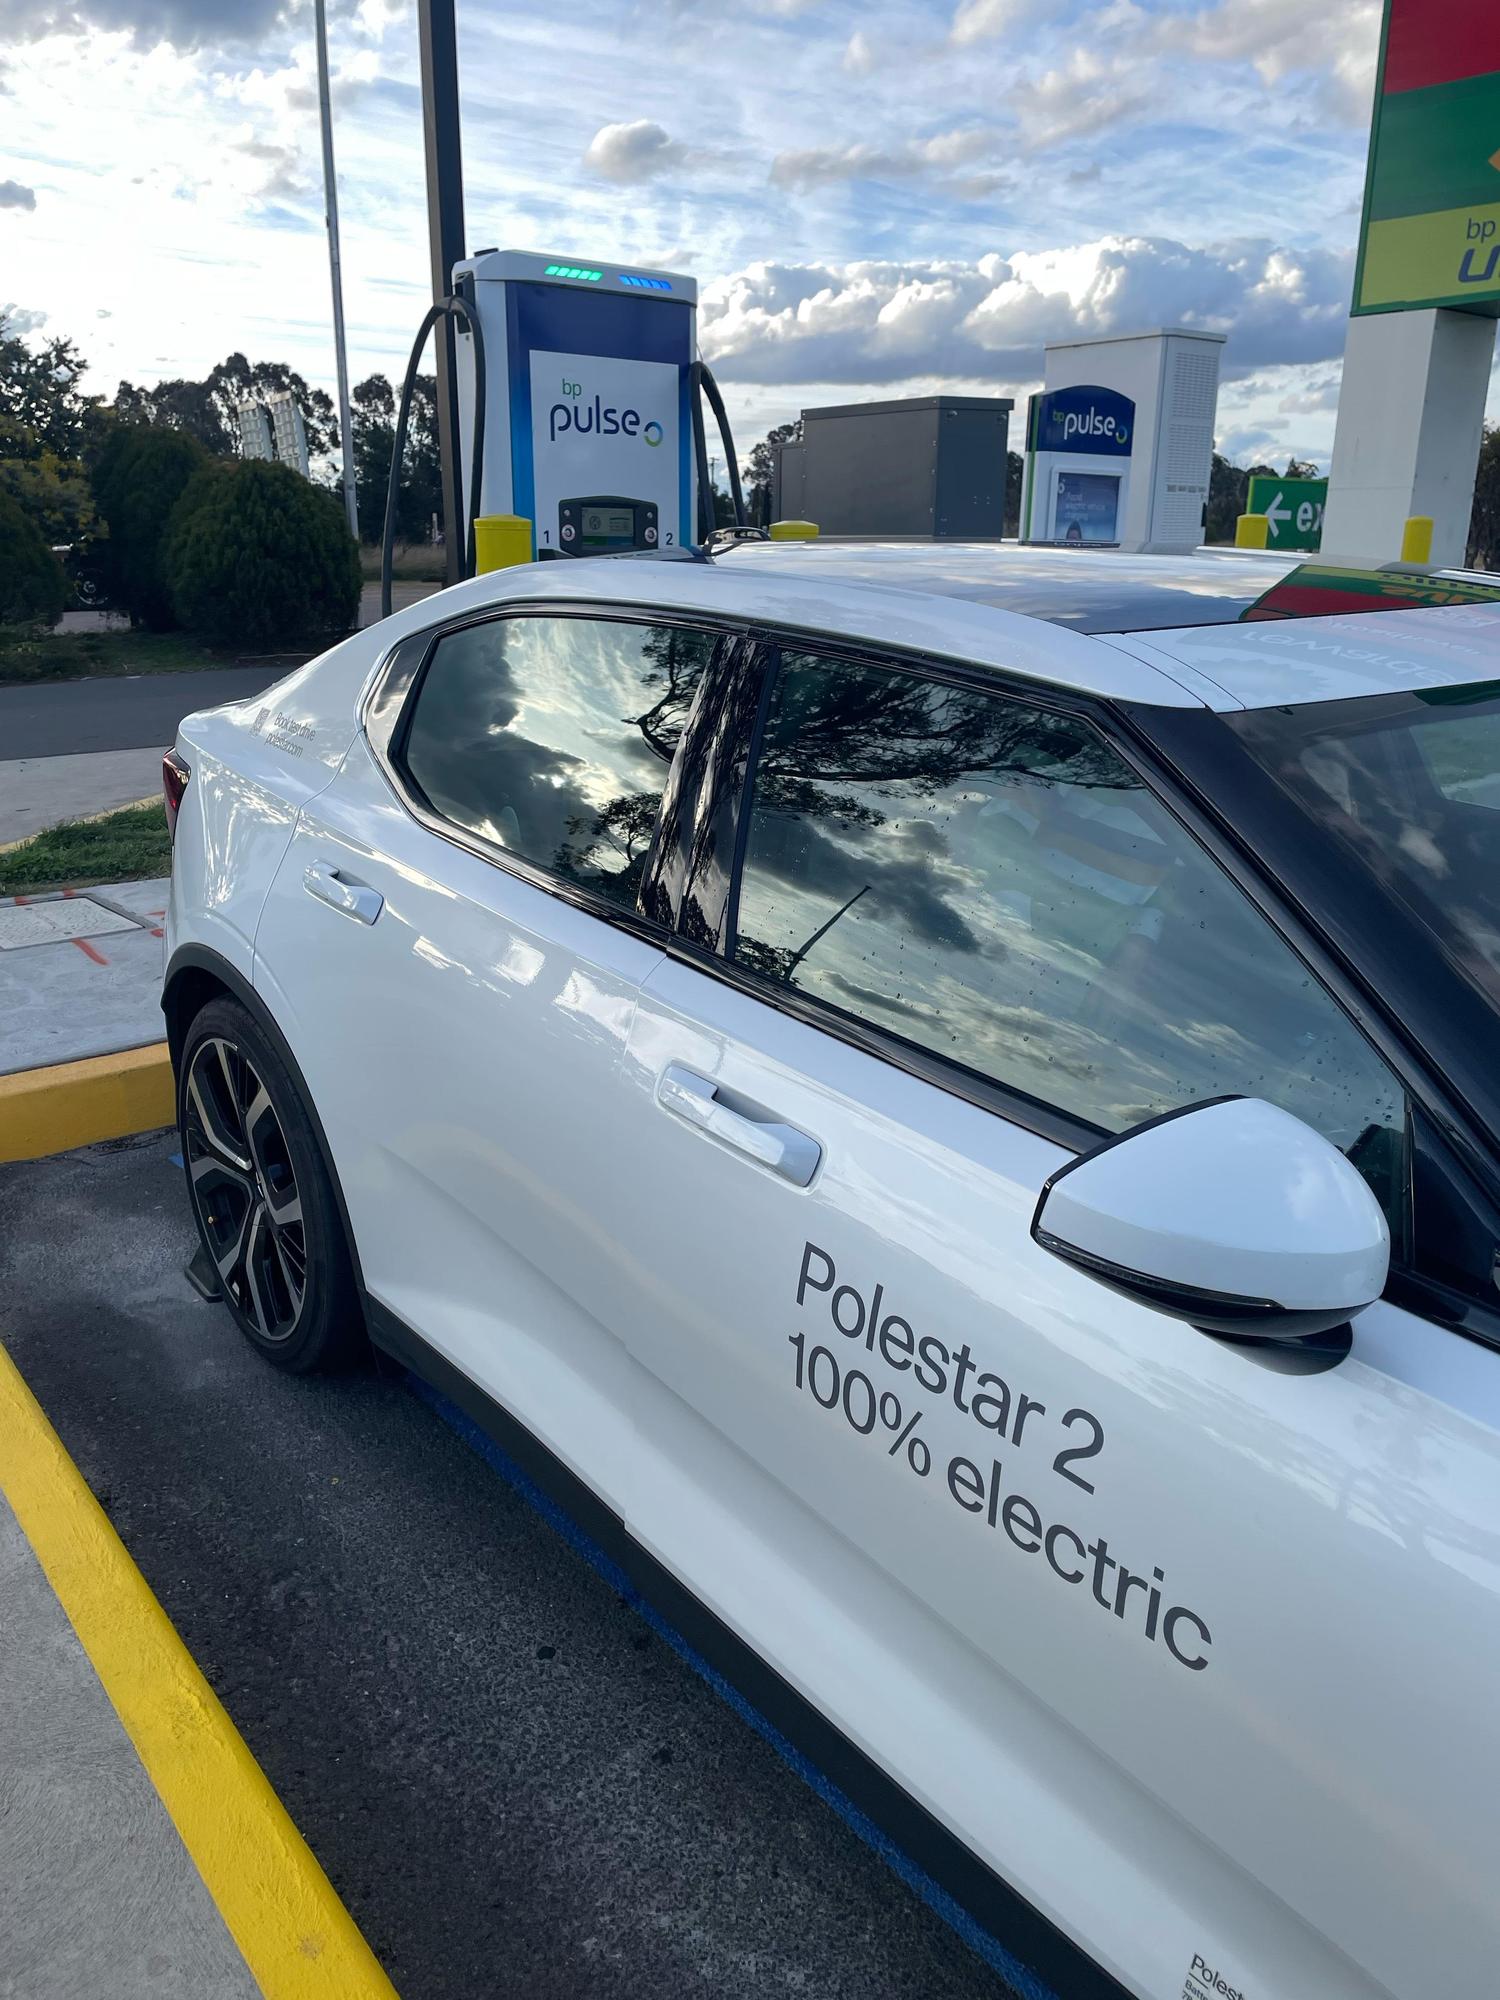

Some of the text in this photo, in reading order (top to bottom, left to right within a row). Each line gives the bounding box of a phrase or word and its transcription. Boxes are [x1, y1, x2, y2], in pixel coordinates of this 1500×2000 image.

[1466, 218, 1496, 243] bp
[562, 378, 582, 399] bp
[550, 395, 640, 441] pulse
[1064, 406, 1116, 440] pulse
[543, 530, 550, 544] 1
[665, 532, 673, 546] 2
[795, 1241, 1105, 1495] Polestar 2
[788, 1332, 1212, 1671] 100% electric
